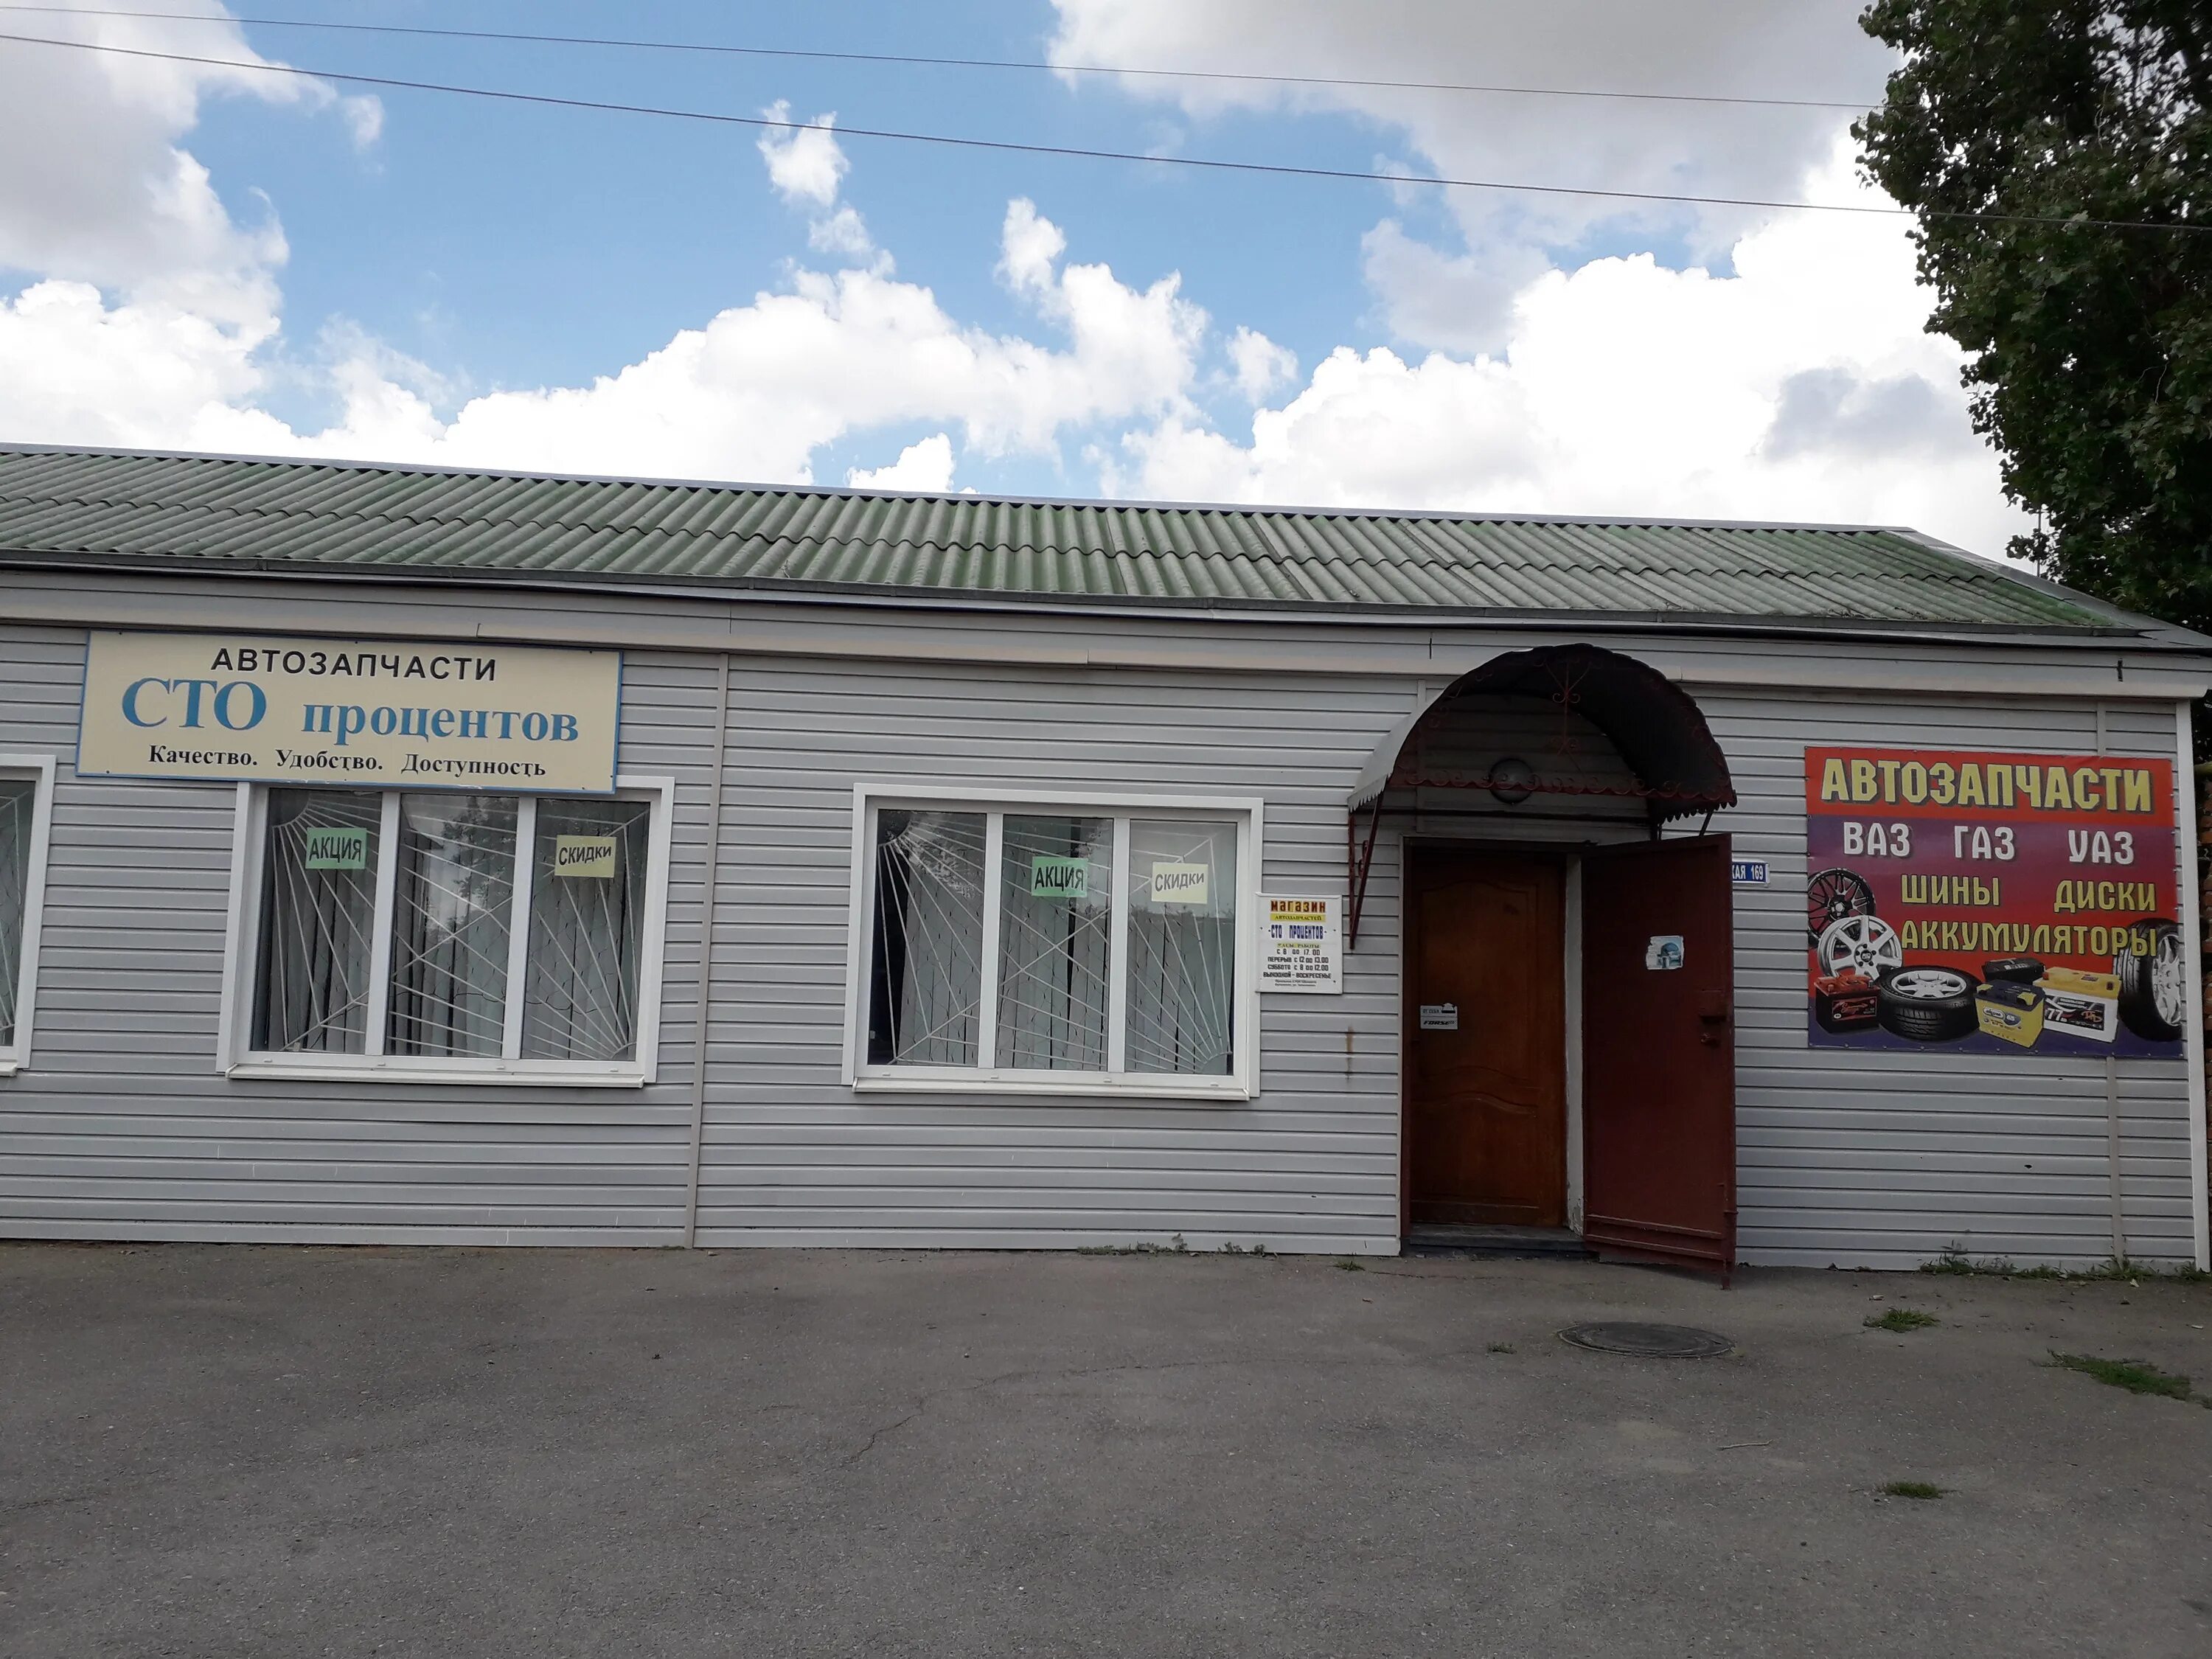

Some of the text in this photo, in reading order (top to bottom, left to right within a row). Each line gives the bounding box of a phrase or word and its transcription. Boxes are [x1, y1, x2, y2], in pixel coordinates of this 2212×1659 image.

[211, 648, 495, 681] АВТОЗАПЧАСТИ
[122, 678, 578, 745] СТО процентов
[148, 745, 546, 778] Качество. Удобство. Доступность
[1820, 758, 2151, 812] АВТОЗАПЧАСТИ
[309, 836, 363, 863] АКЦИЯ
[558, 846, 611, 866] СКИДКИ
[1843, 821, 2134, 865] ВАЗ ГАЗ УАЗ
[1034, 866, 1084, 891] АКЦИЯ
[1155, 872, 1204, 892] СКИДКИ
[1750, 865, 1763, 880] 169
[1901, 874, 2156, 913] ШИНЫ ДИСКИ
[1271, 925, 1324, 939] СТО ПРОЦЕНТОВ
[1901, 919, 2157, 957] АККУМУЛЯТОРЫ
